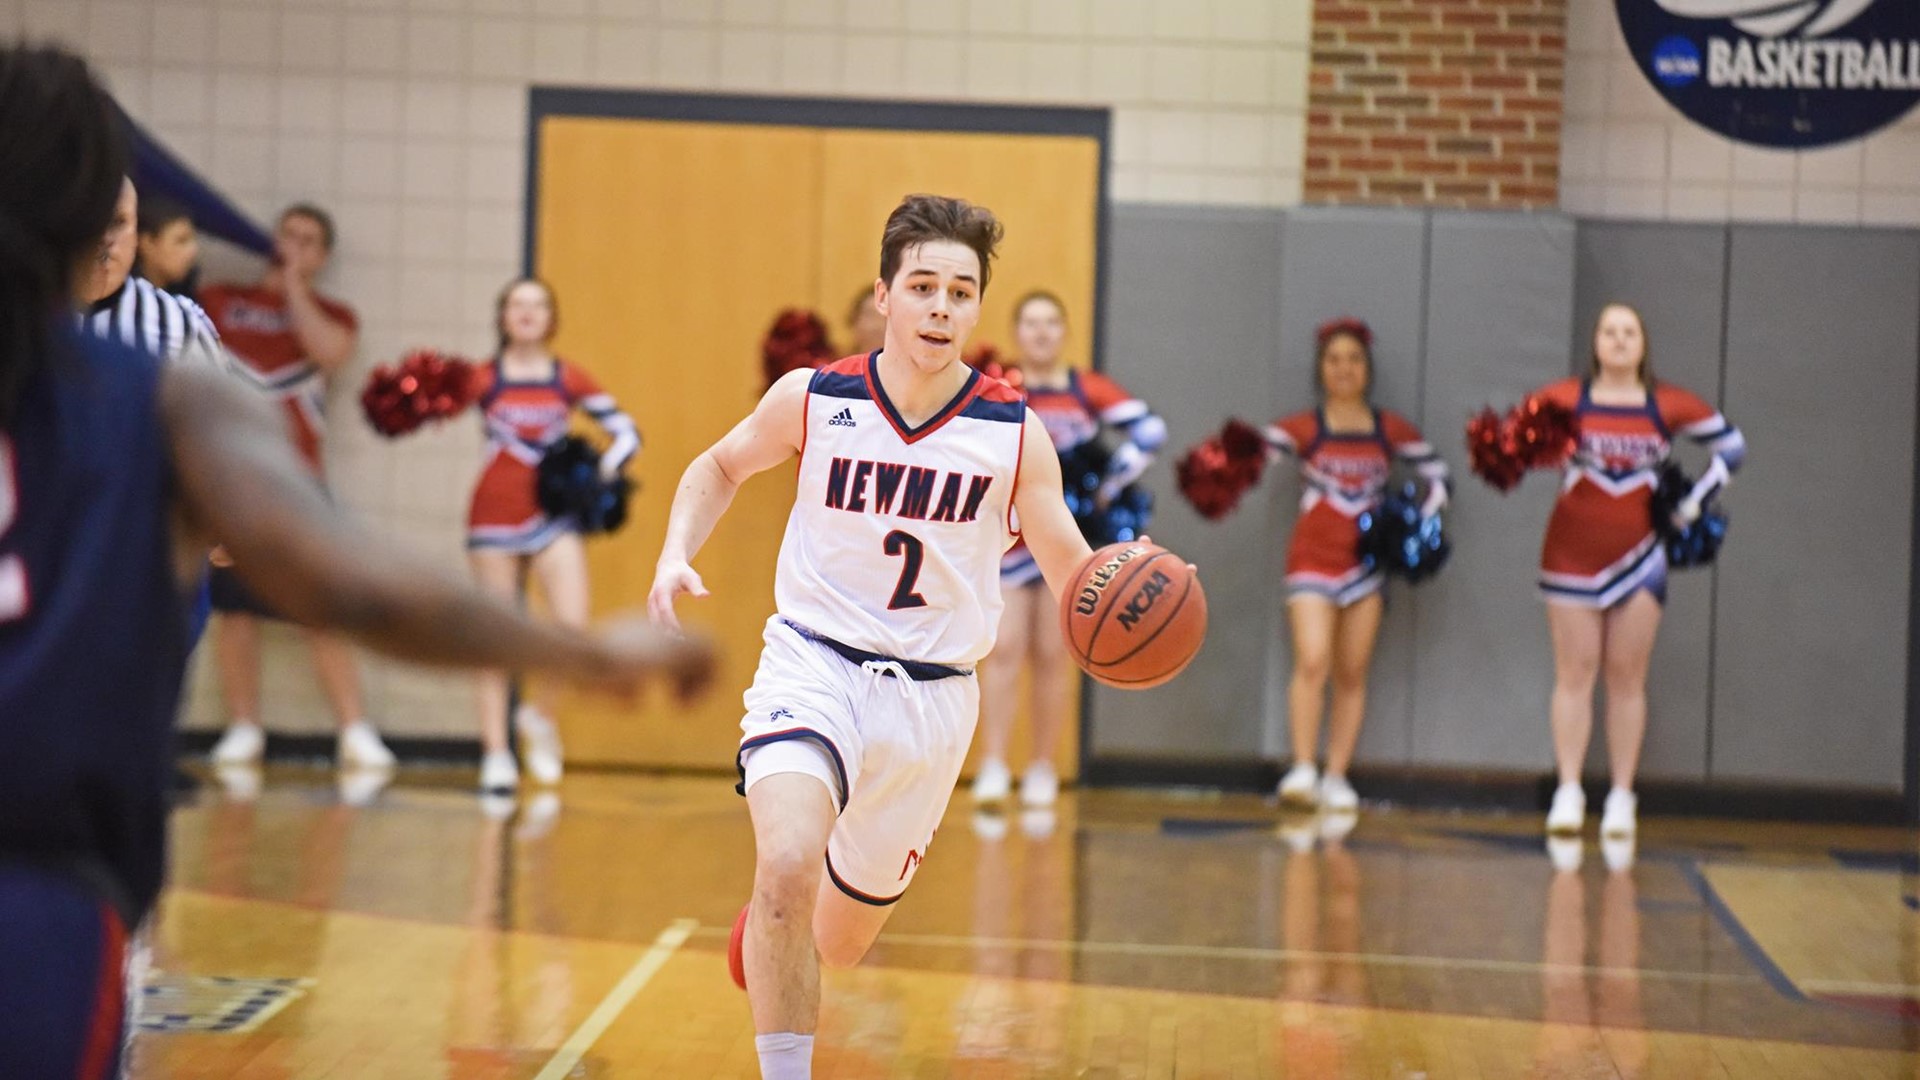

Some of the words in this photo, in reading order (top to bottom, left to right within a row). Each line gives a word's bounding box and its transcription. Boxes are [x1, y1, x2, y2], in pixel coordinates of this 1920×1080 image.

[1706, 38, 1920, 89] BASKETBALL
[828, 418, 857, 428] adidas
[825, 457, 993, 523] NEWMAN
[883, 529, 928, 610] 2
[1116, 569, 1171, 632] NCAA
